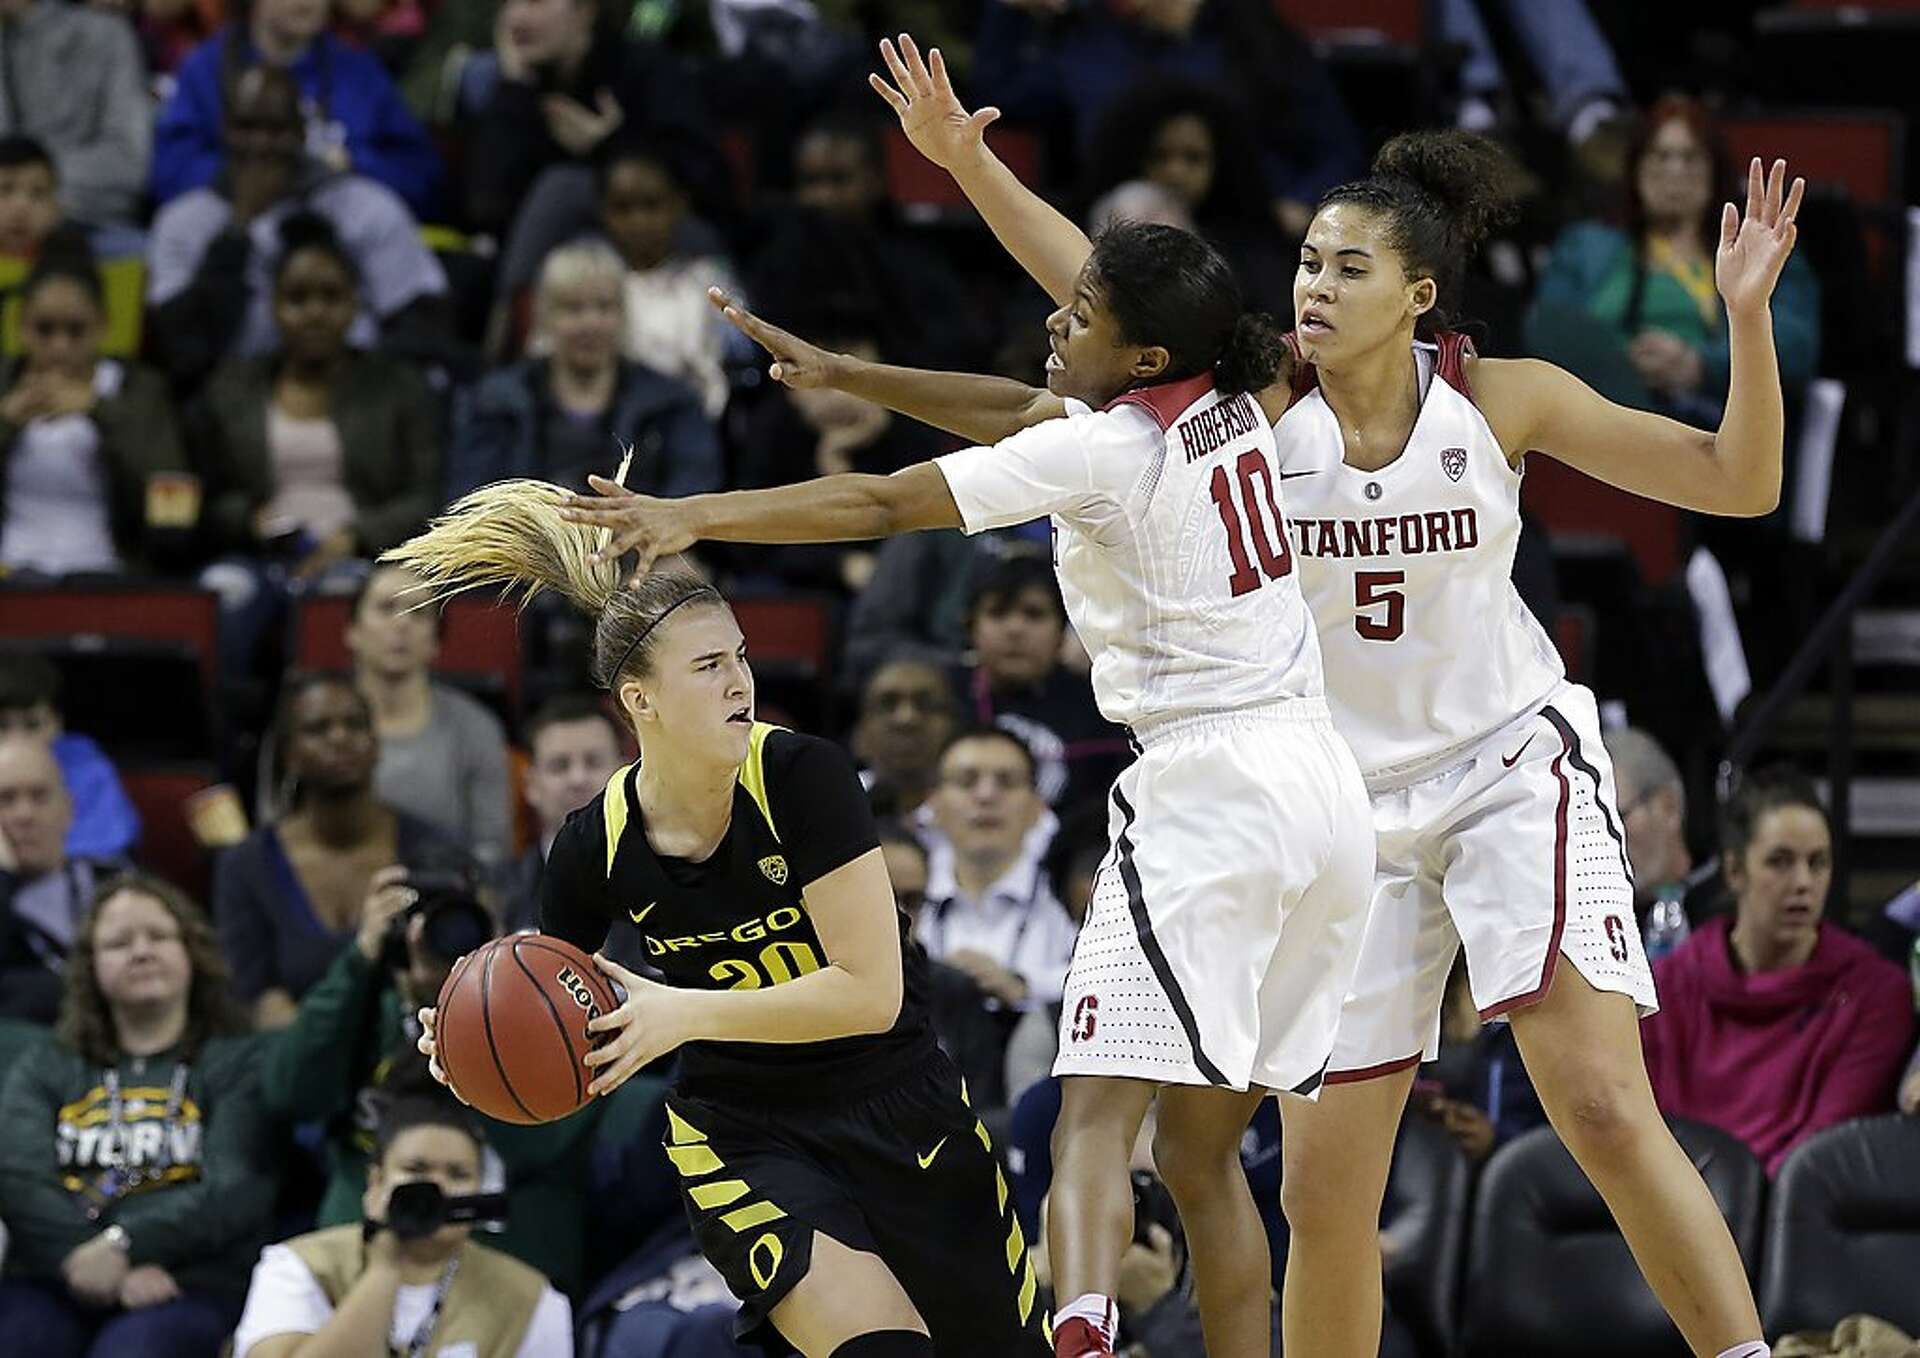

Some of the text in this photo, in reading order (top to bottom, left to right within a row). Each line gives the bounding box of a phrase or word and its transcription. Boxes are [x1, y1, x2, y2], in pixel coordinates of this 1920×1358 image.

[1177, 391, 1259, 464] ROBERSON
[1210, 448, 1292, 598] 10
[1287, 508, 1478, 558] TANFORD
[1355, 571, 1405, 641] 5
[645, 899, 807, 956] OREGO
